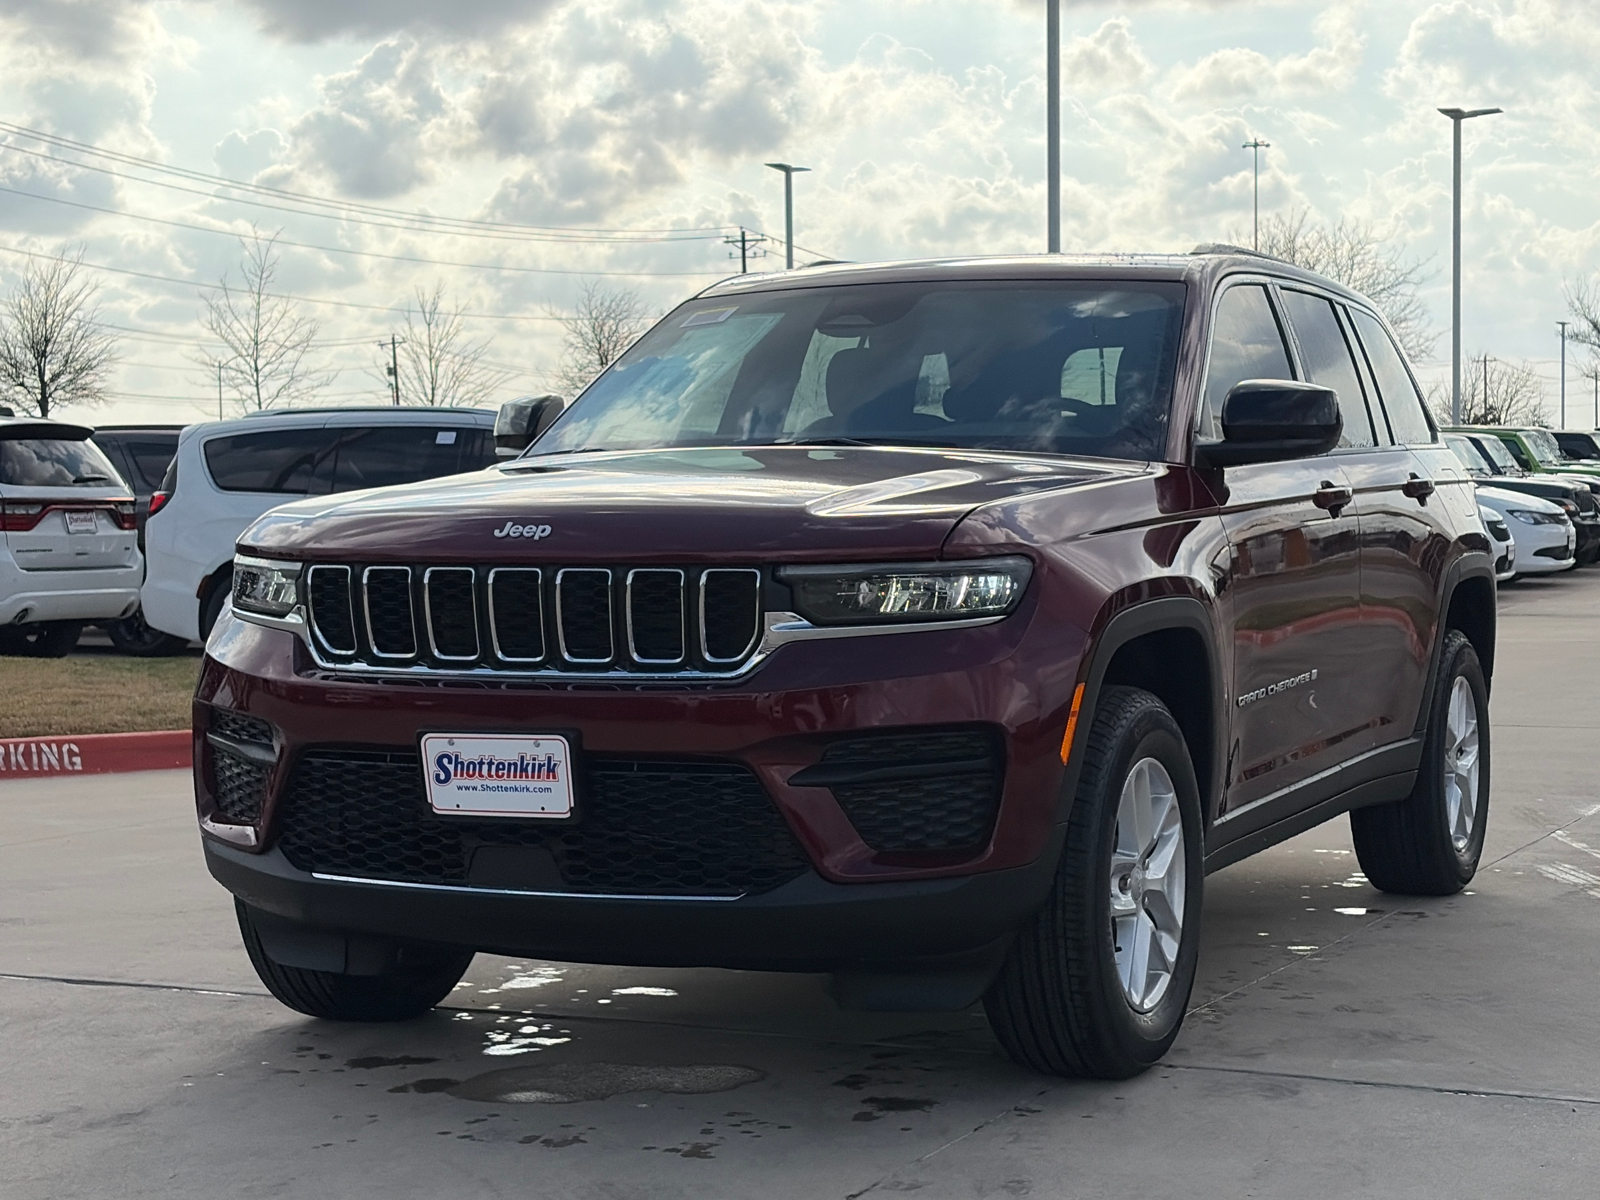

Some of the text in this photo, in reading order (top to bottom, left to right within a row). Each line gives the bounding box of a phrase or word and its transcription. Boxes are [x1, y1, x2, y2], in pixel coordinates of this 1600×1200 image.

[494, 521, 552, 540] Jeep
[1238, 672, 1311, 707] GRAND CHEROKEE
[434, 752, 560, 785] Shottenkirk
[456, 783, 553, 794] www.Shottenkirk.com
